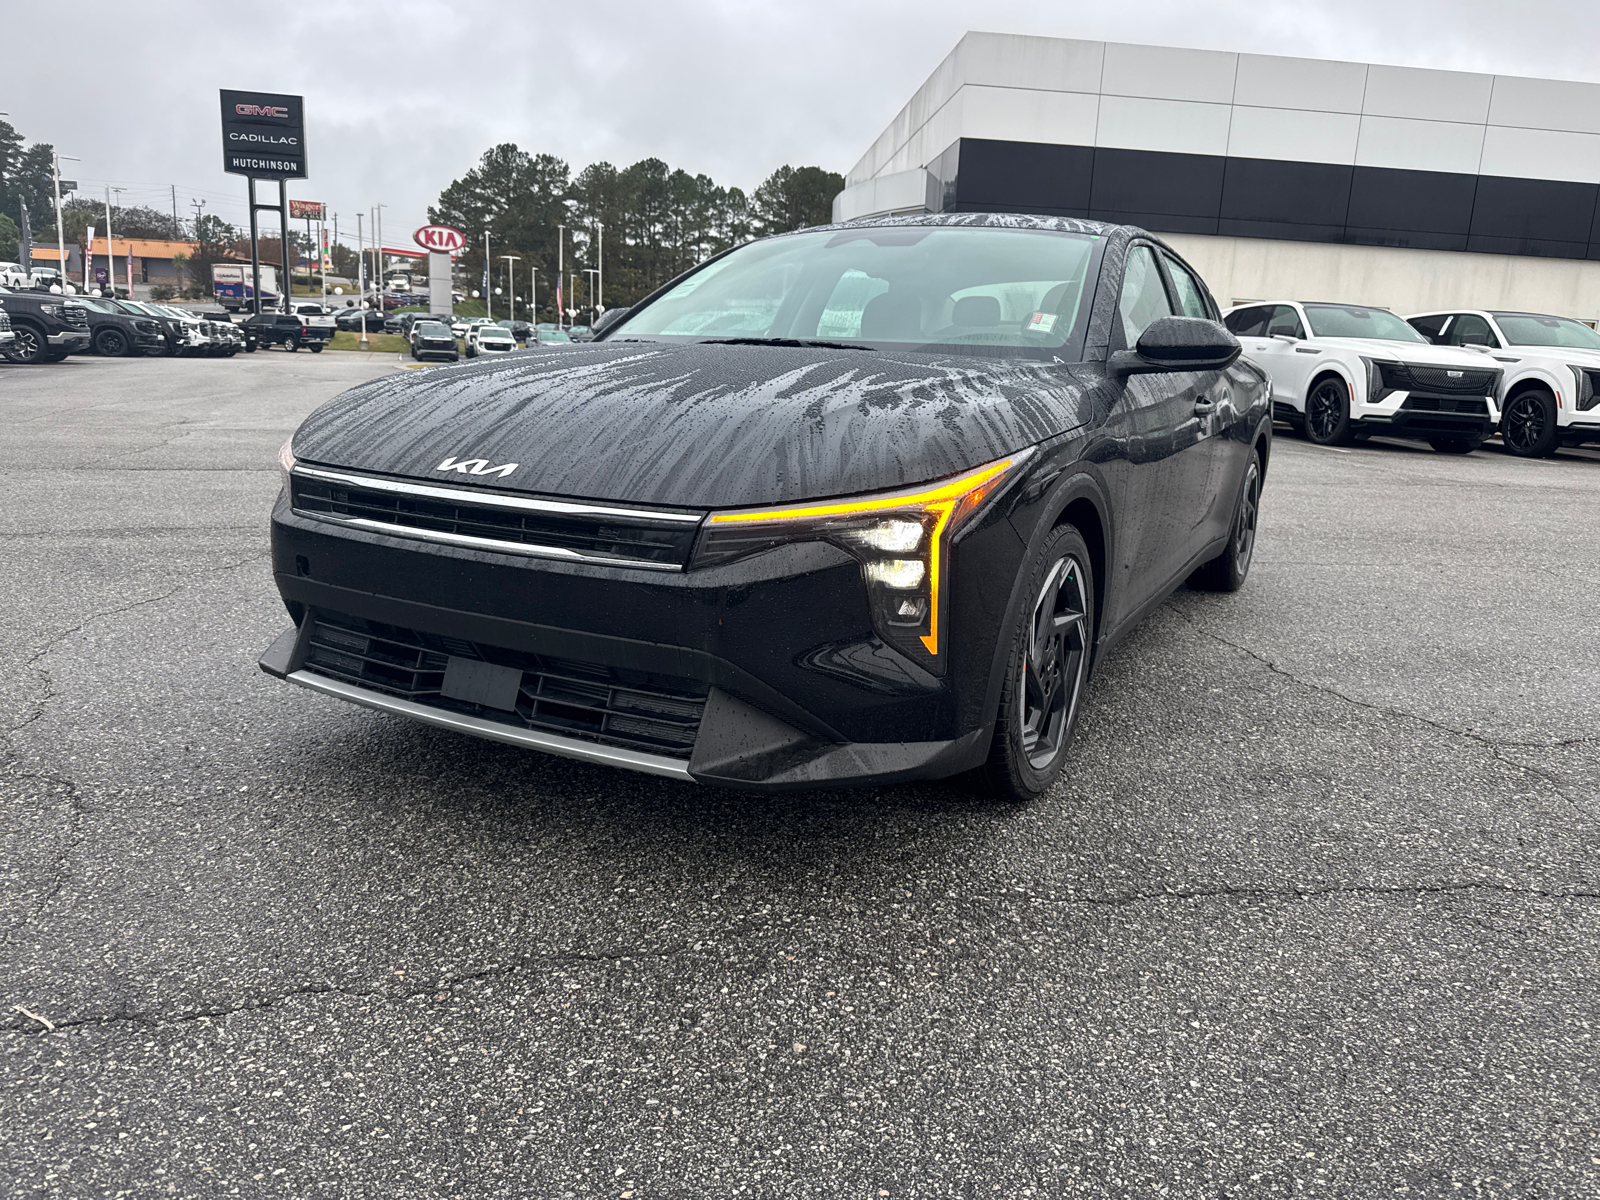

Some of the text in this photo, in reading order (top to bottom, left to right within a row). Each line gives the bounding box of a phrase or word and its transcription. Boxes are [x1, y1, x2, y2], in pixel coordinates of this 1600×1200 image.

[236, 104, 288, 118] GMC
[229, 133, 298, 145] CADILLAC
[233, 158, 297, 171] HUTCHINSON
[291, 201, 321, 211] Wager
[423, 229, 458, 248] KIA
